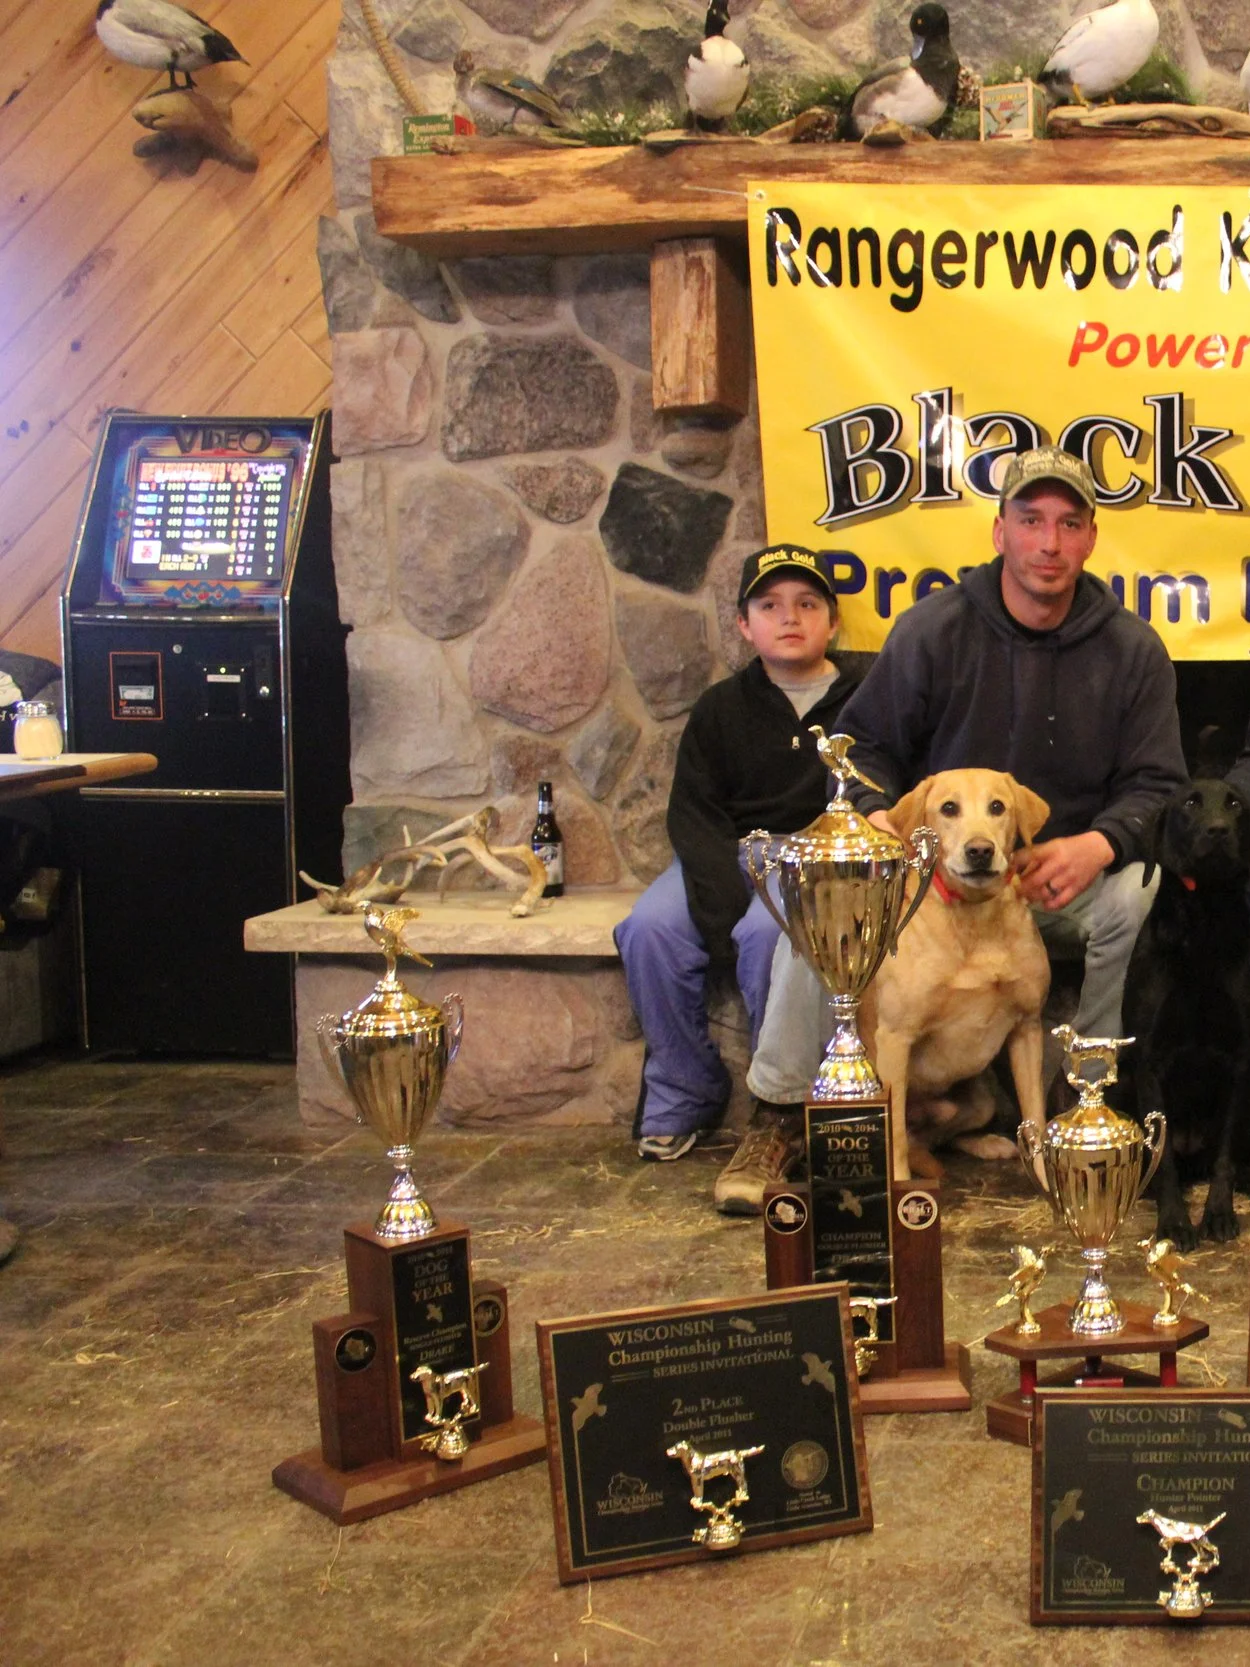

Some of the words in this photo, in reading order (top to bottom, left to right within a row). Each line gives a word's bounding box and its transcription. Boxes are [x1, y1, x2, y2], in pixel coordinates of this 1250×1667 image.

[765, 204, 1184, 313] Rangerwood
[175, 427, 272, 454] VIDEO
[804, 386, 1246, 527] Black
[759, 549, 788, 569] Black
[791, 551, 816, 567] Gold
[818, 550, 1211, 624] Prem
[827, 1136, 870, 1151] DOG
[823, 1164, 875, 1178] YEAR
[414, 1259, 448, 1276] DOG
[412, 1282, 453, 1304] YEAR
[608, 1319, 715, 1347] WISCONSIN
[608, 1340, 721, 1366] Championship
[727, 1330, 793, 1349] Hunting
[653, 1362, 698, 1379] SERIES
[701, 1349, 794, 1373] INVITATIONAL
[700, 1395, 744, 1412] PLACE
[663, 1417, 707, 1434] Double
[709, 1410, 755, 1427] Flusher
[1088, 1407, 1200, 1424] WISCONSIN
[1087, 1428, 1206, 1448] Championship
[1132, 1451, 1178, 1463] SERIES
[1136, 1474, 1235, 1492] CHAMPION
